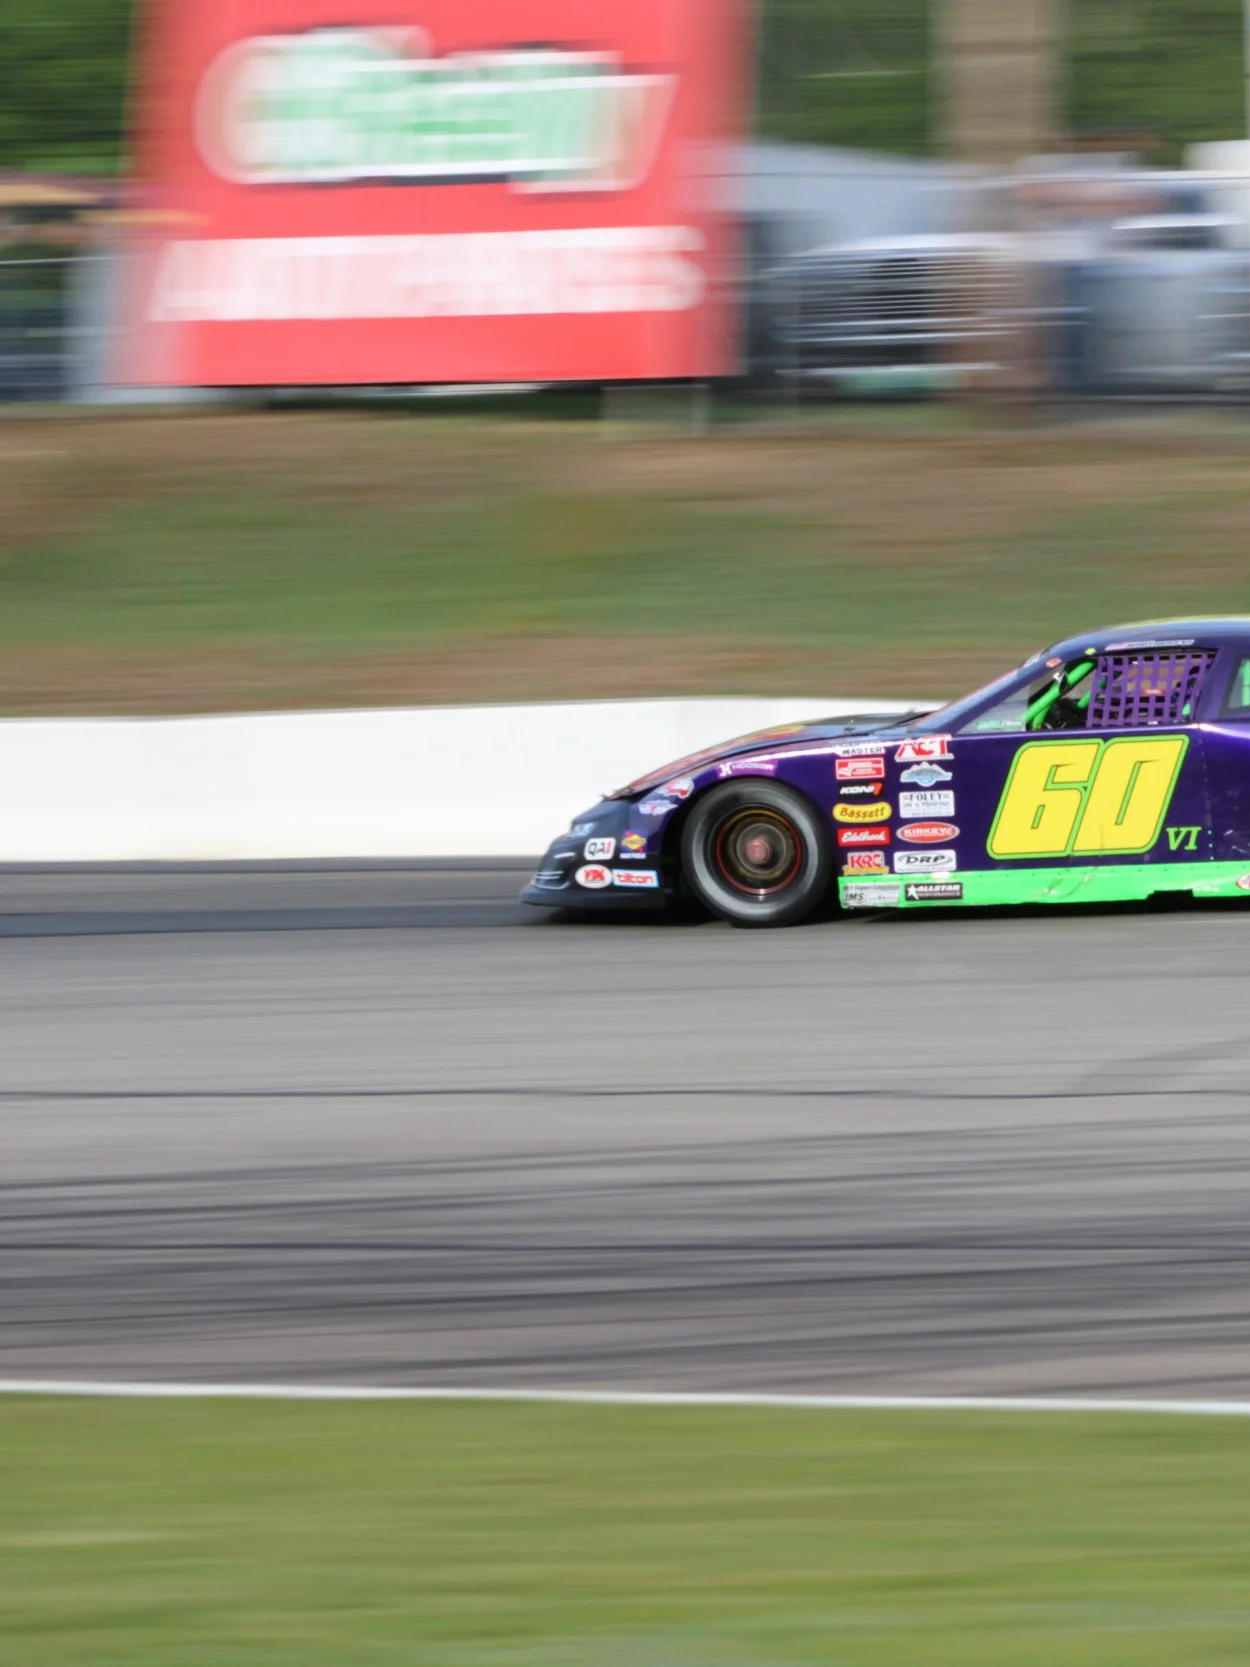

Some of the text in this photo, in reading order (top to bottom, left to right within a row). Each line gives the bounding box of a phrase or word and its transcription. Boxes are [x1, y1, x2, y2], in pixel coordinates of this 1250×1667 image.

[842, 746, 882, 756] MASTER
[896, 737, 950, 759] ACT
[840, 785, 876, 795] KONI
[986, 734, 1190, 860] 60
[840, 806, 885, 819] Bassett
[841, 831, 886, 843] Edelbrock
[588, 841, 612, 856] QA1
[849, 854, 882, 869] KRC
[905, 855, 946, 864] DRP
